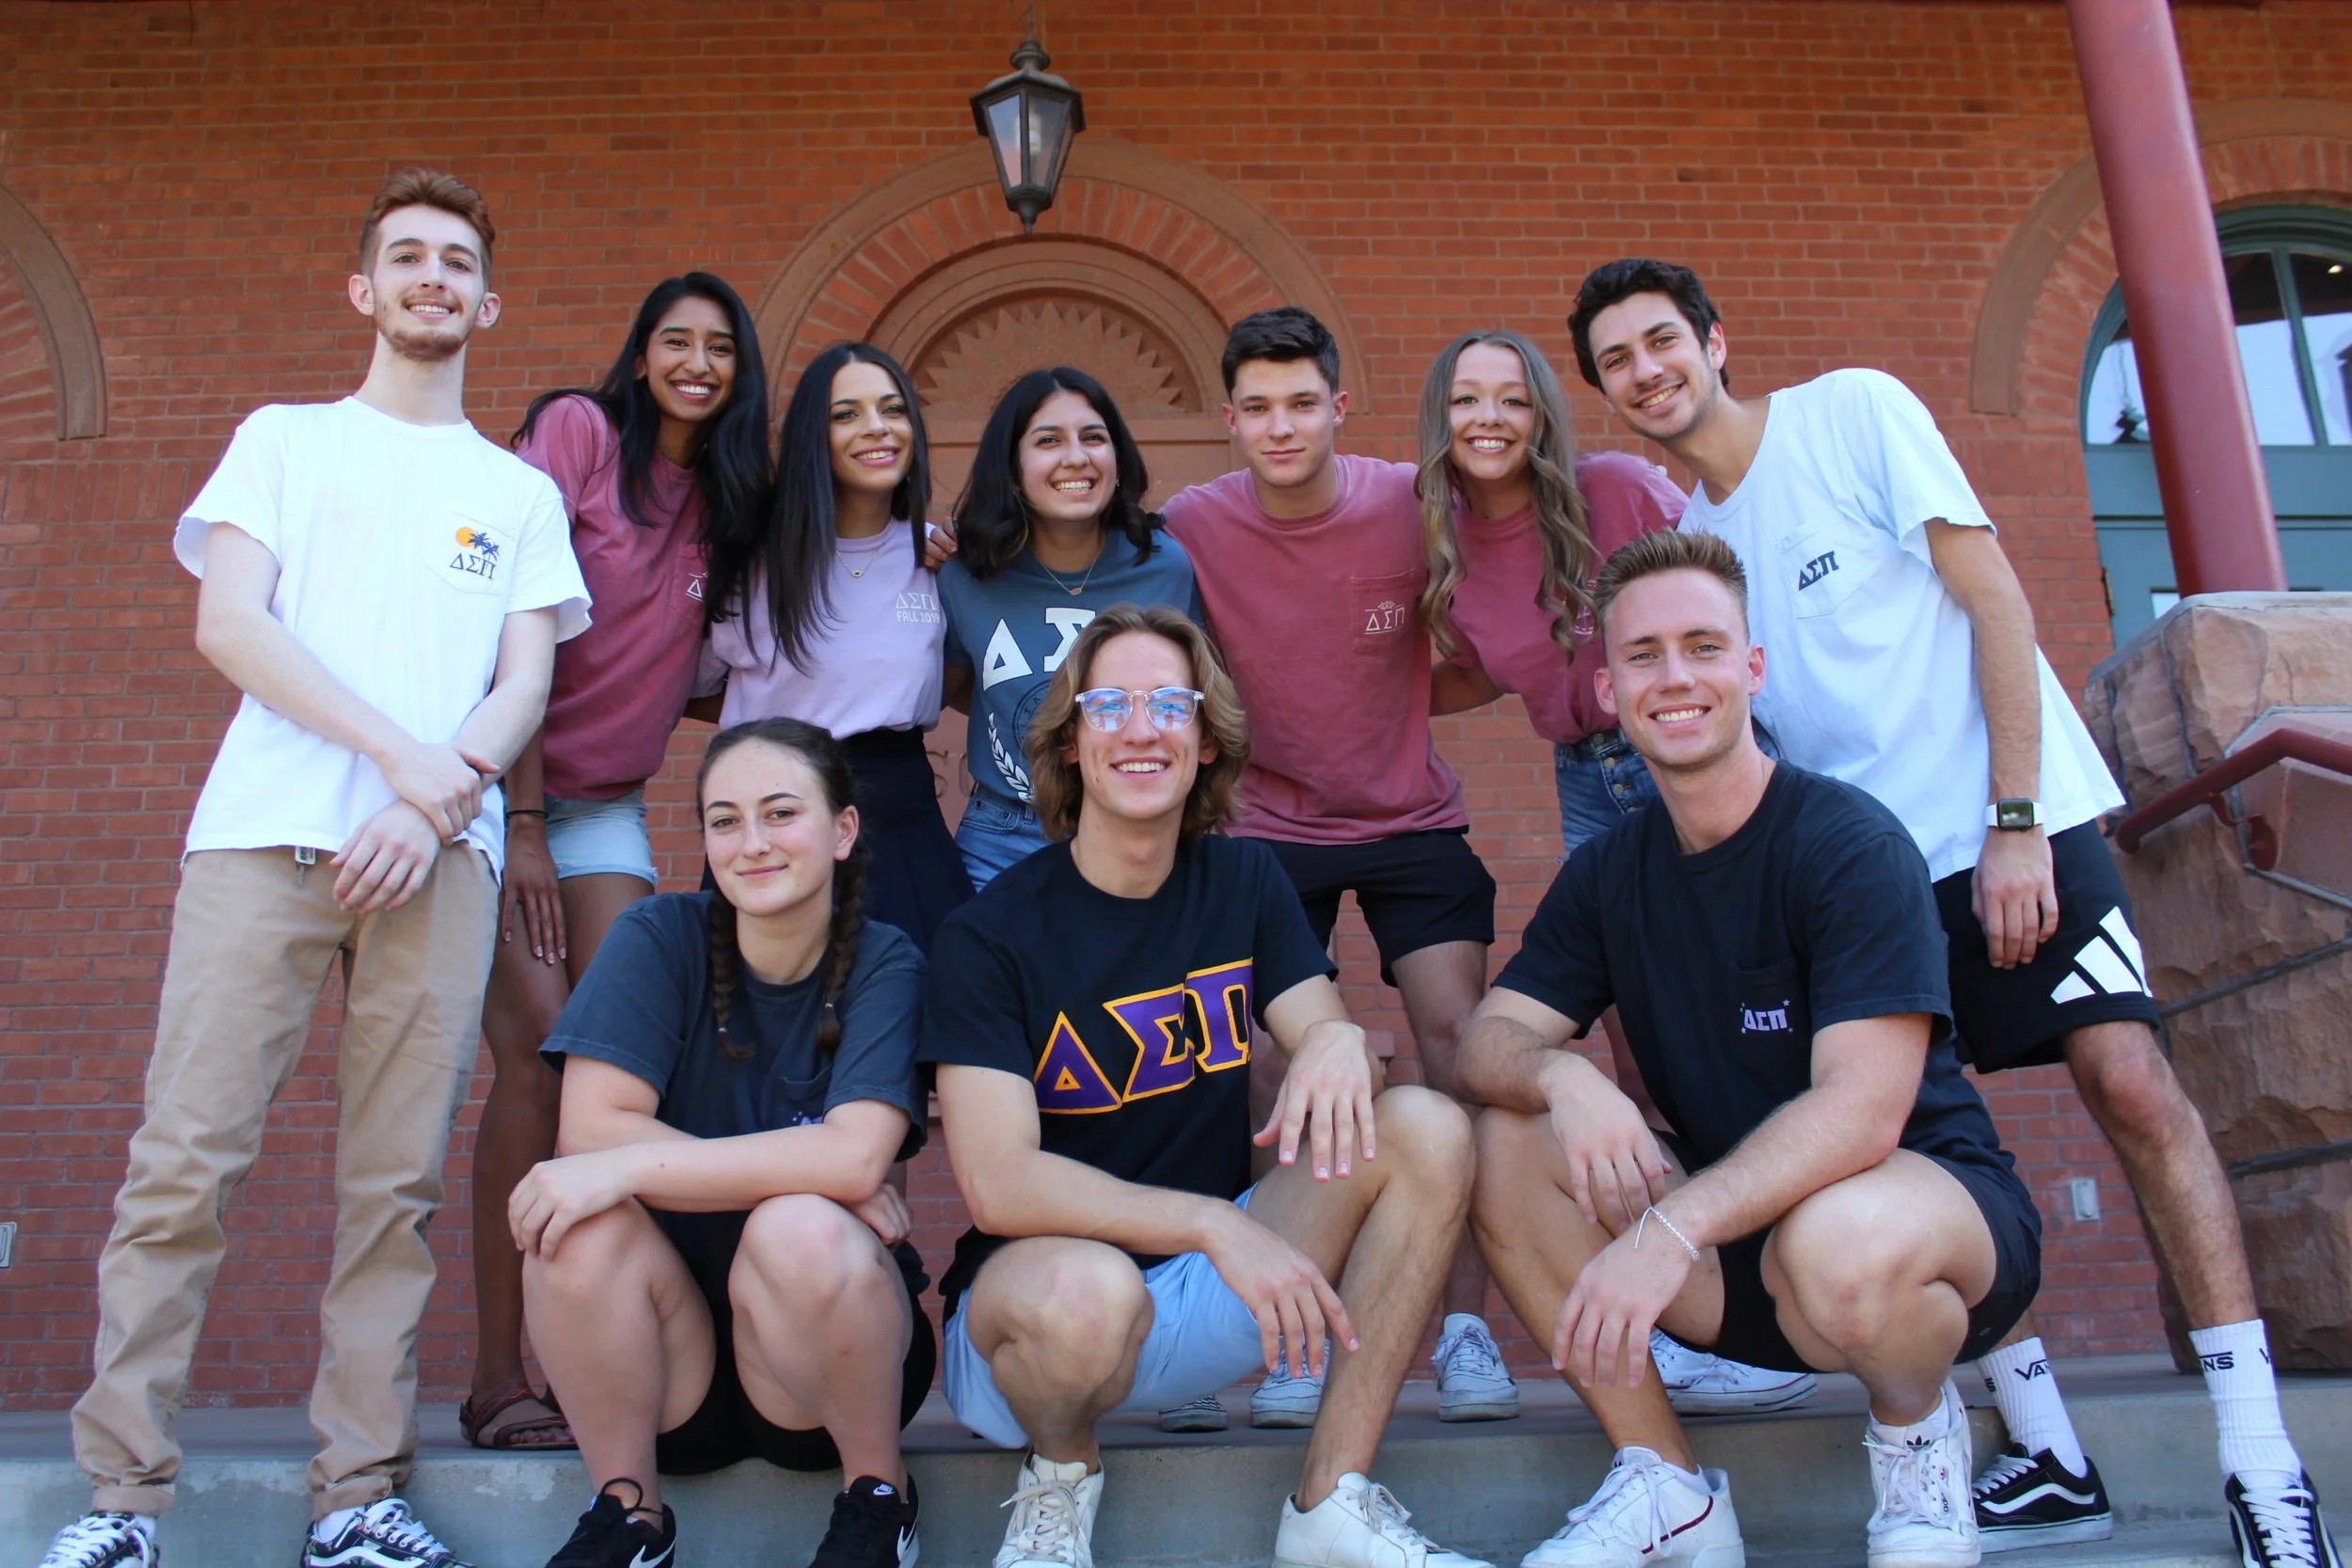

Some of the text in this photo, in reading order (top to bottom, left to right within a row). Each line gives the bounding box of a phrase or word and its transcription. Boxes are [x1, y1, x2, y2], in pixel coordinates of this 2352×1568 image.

[450, 552, 497, 580] ΔΣΠ
[1798, 550, 1839, 591] ΔΣΠ
[896, 593, 937, 610] ΔΣΠ
[897, 610, 940, 624] FALL 2019
[1365, 607, 1405, 631] ΔΣΠ
[982, 607, 1096, 691] ΔΣ
[1033, 957, 1253, 1116] ΔΣΠ
[2199, 1352, 2234, 1371] NS
